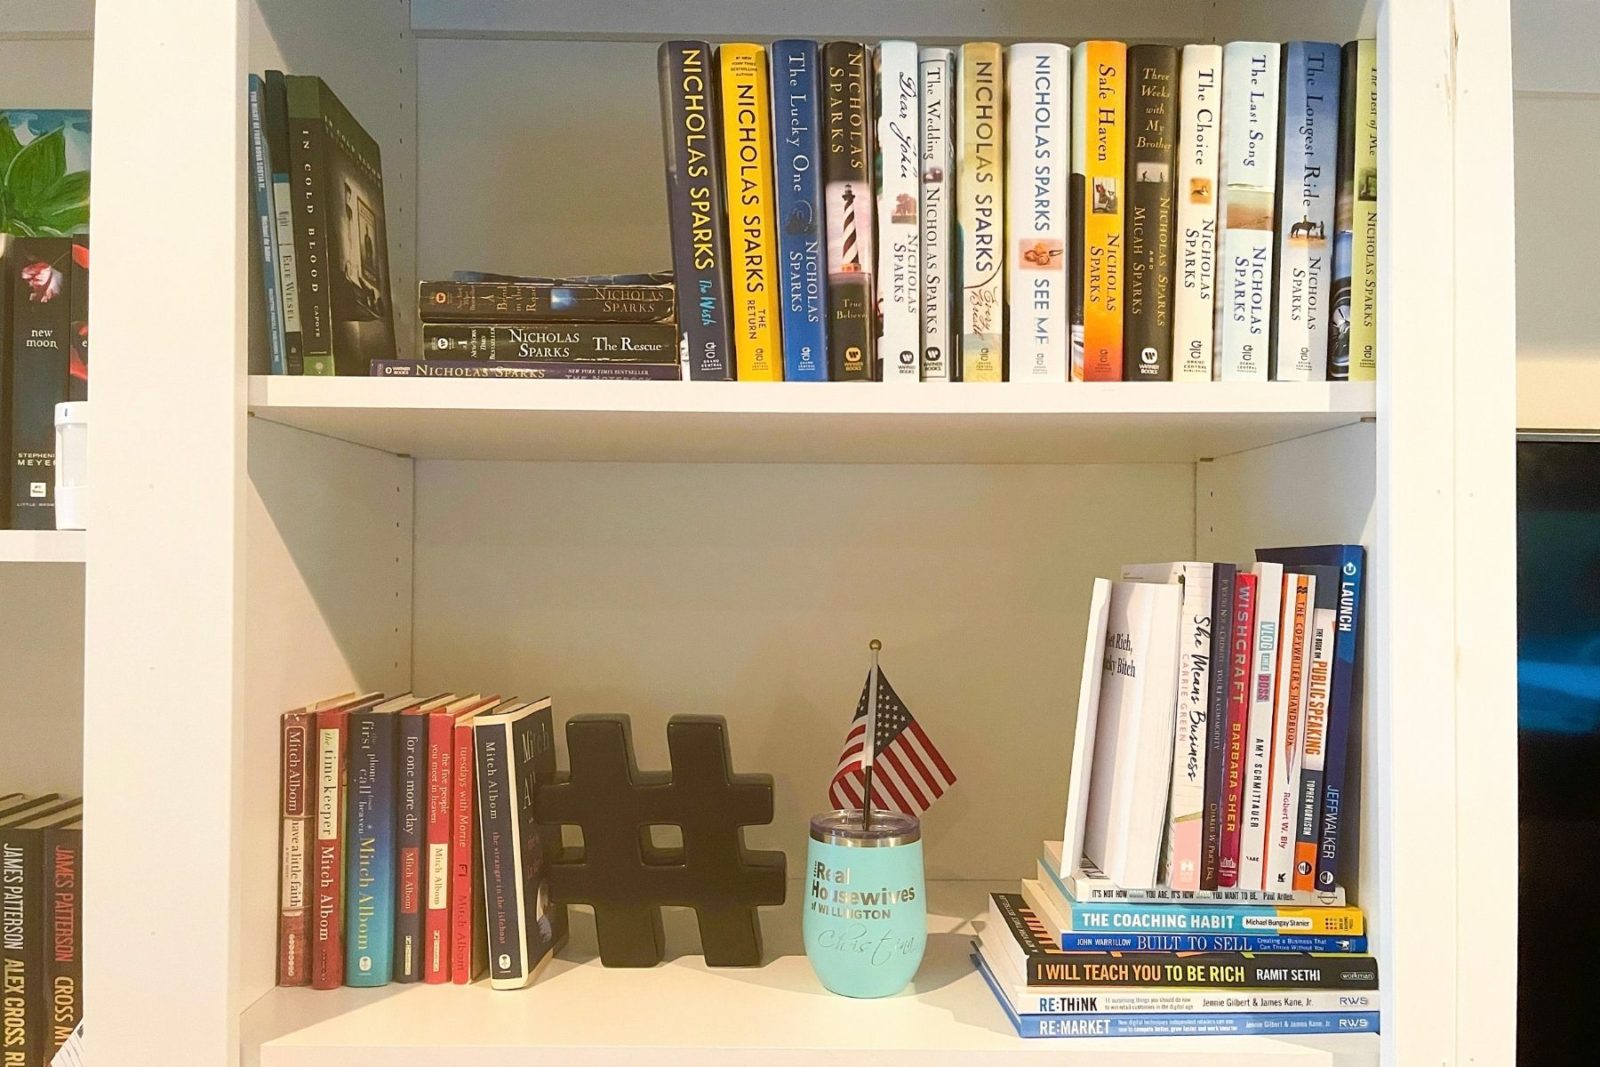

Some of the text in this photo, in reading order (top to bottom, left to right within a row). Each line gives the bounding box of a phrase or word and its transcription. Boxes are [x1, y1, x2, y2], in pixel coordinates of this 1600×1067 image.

[1141, 85, 1170, 98] Weeks
[1142, 68, 1170, 81] Three
[786, 52, 810, 192] The Lucky One
[1098, 63, 1116, 161] Safe Haven
[1145, 104, 1165, 115] with
[1145, 120, 1165, 135] My
[1195, 69, 1214, 165] The Choice
[1243, 54, 1266, 167] The Last Song
[1299, 52, 1325, 207] The Longest Ride
[302, 130, 310, 149] IN
[682, 50, 714, 270] NICHOLAS SPARKS
[737, 84, 759, 206] NICHOLAS
[1034, 55, 1050, 231] NICHOLAS SPARKS
[1136, 137, 1172, 150] Brother
[304, 163, 314, 213] COLD
[975, 61, 993, 272] NICHOLAS SPARKS
[923, 67, 941, 334] The Wedding NICHOLAS SPARKS
[307, 228, 319, 293] BLOOD
[743, 215, 764, 293] SPARKS
[893, 243, 906, 303] SPARKS
[907, 233, 918, 314] NICHOLAS
[1132, 206, 1146, 315] MICAH SPARKS
[1157, 198, 1170, 327] NICHOLAS SPARKS
[1363, 211, 1377, 328] NICHOLAS SPARKS
[1034, 278, 1050, 310] SEE
[1234, 256, 1249, 322] SPARKS
[1250, 246, 1266, 335] NICHOLAS
[31, 328, 53, 338] new
[508, 329, 580, 343] NICHOLAS
[747, 300, 758, 339] RETURN
[758, 309, 766, 328] THE
[26, 339, 58, 349] moon
[518, 344, 570, 358] SPARKS
[592, 337, 662, 352] The Rescue
[1339, 581, 1355, 632] LAUNCH
[1115, 633, 1132, 655] Rich,
[1232, 586, 1250, 704] WISHCRAFT
[1260, 622, 1274, 650] VLOG
[1117, 657, 1136, 678] Bitch
[1257, 674, 1271, 702] BOSS
[1287, 602, 1306, 746] THE COPYWRITER'S HANDBOOK
[1179, 653, 1190, 742] CARRIE GREEN
[1187, 614, 1211, 782] She Means Business
[1305, 660, 1328, 756] PUBLIC SPEAKING
[485, 741, 498, 776] Mitch
[1226, 723, 1241, 832] BARBARA SHER
[1250, 738, 1264, 828] AMY SCHMITTAUER
[319, 750, 336, 835] time keeper
[403, 736, 418, 835] for one more day
[430, 795, 439, 824] heaven
[439, 786, 449, 815] people
[488, 781, 499, 819] Albom
[1282, 792, 1291, 820] Robert
[1302, 779, 1316, 836] TOPHER MORRISON
[459, 790, 469, 848] with Morrie
[3, 844, 24, 882] JAMES
[290, 853, 302, 907] little faith
[405, 852, 414, 909] Mitch Albom
[434, 848, 443, 904] Mitch Albom
[817, 861, 850, 884] Real
[319, 846, 335, 941] Mitch Albom
[358, 837, 376, 950] Mitch Albom
[811, 879, 915, 905] Housewives
[818, 902, 891, 919] WILLINGTON
[1103, 889, 1114, 898] NOT
[1115, 889, 1127, 898] HOW
[1145, 890, 1156, 899] YOU
[1182, 890, 1194, 899] HOW
[1212, 891, 1223, 899] YOU
[1224, 891, 1239, 899] WANT
[3, 885, 24, 950] PATTERSON
[54, 845, 74, 1022] JAMES PATTERSON CROSS
[1082, 913, 1234, 929] THE COACHING HABIT
[1245, 918, 1310, 928] Michael Bungay Stanier
[457, 933, 467, 971] Albom
[1077, 935, 1253, 951] JOHN WARRILLOW BUILT TO SELL
[4, 958, 25, 993] ALEX
[1045, 964, 1245, 982] WILL TEACH YOU TO BE RICH
[1256, 969, 1321, 981] RAMIT SETHI
[3, 998, 25, 1048] CROSS,
[1202, 998, 1303, 1007] Jennie Gilbert & James Kane,
[1339, 997, 1368, 1005] RWS
[1339, 1019, 1368, 1028] RWS
[1040, 1019, 1111, 1035] RE:MARKET
